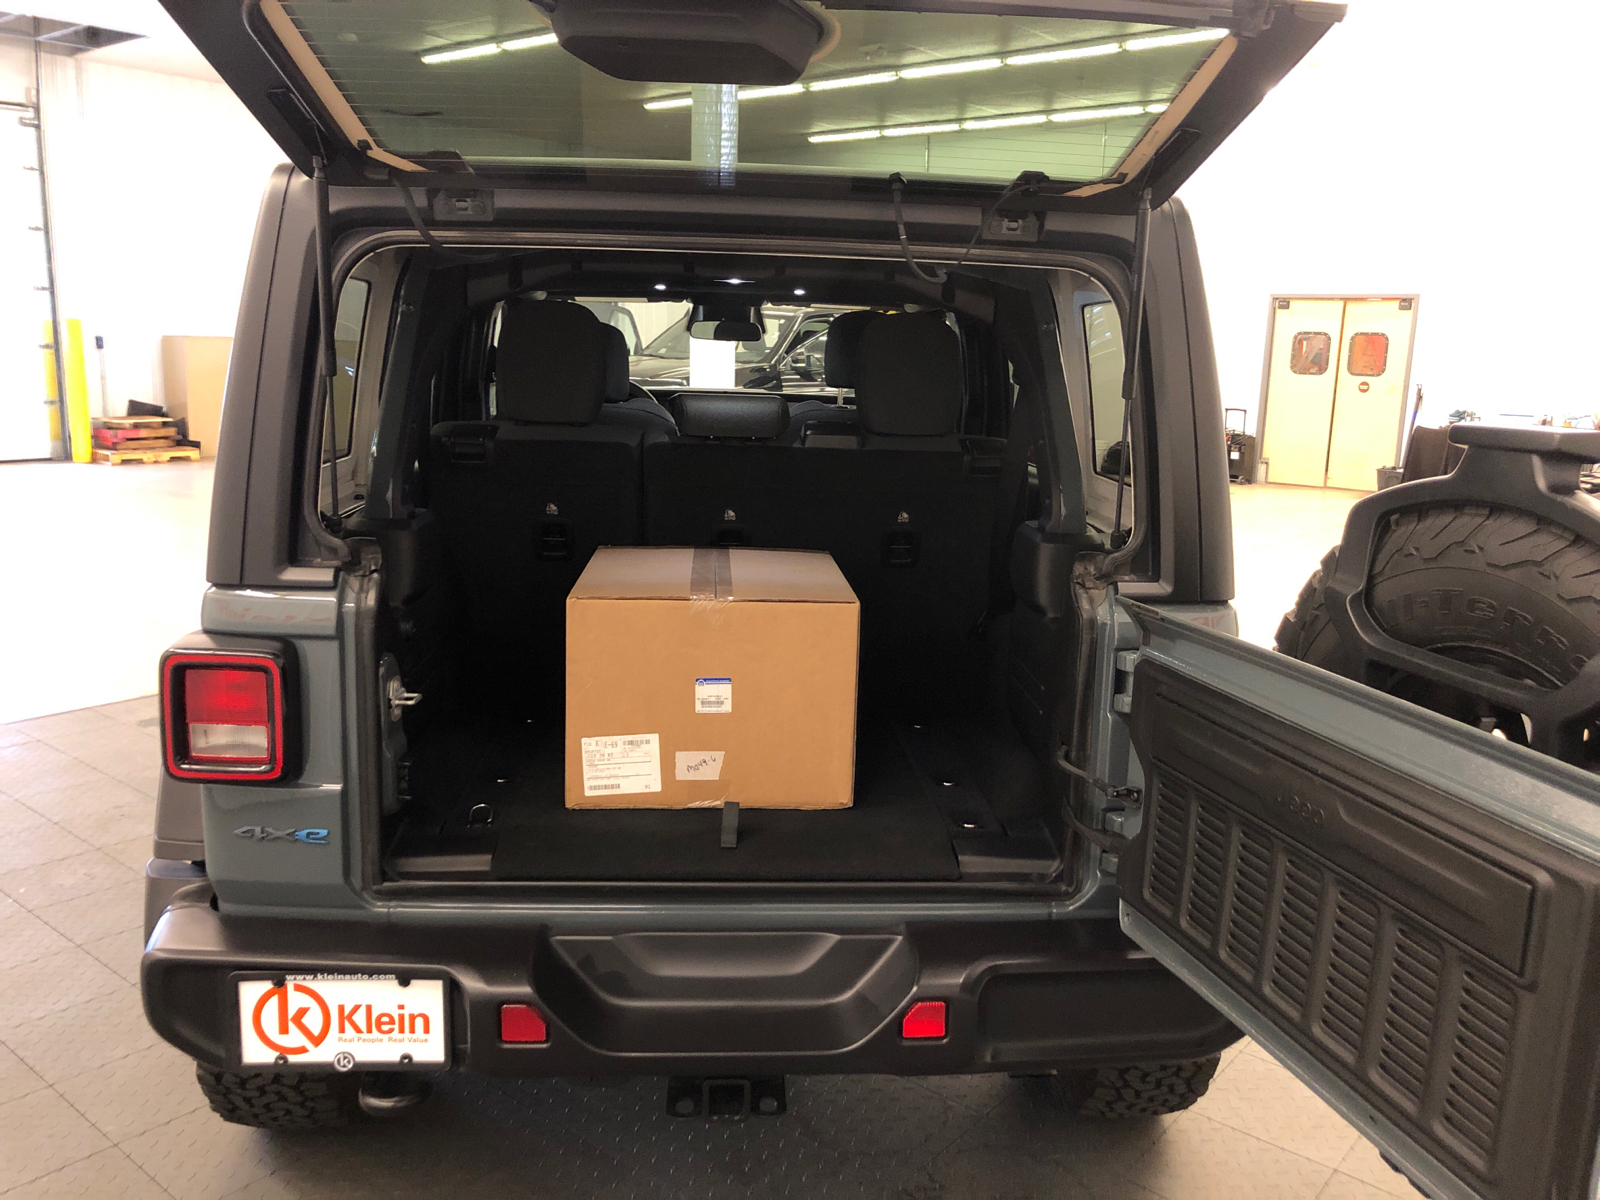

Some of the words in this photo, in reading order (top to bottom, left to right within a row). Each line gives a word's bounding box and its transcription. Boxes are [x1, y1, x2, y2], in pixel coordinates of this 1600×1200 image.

[285, 972, 396, 981] www.kleinauto.com
[337, 1004, 430, 1034] Klein
[357, 1036, 384, 1044] People
